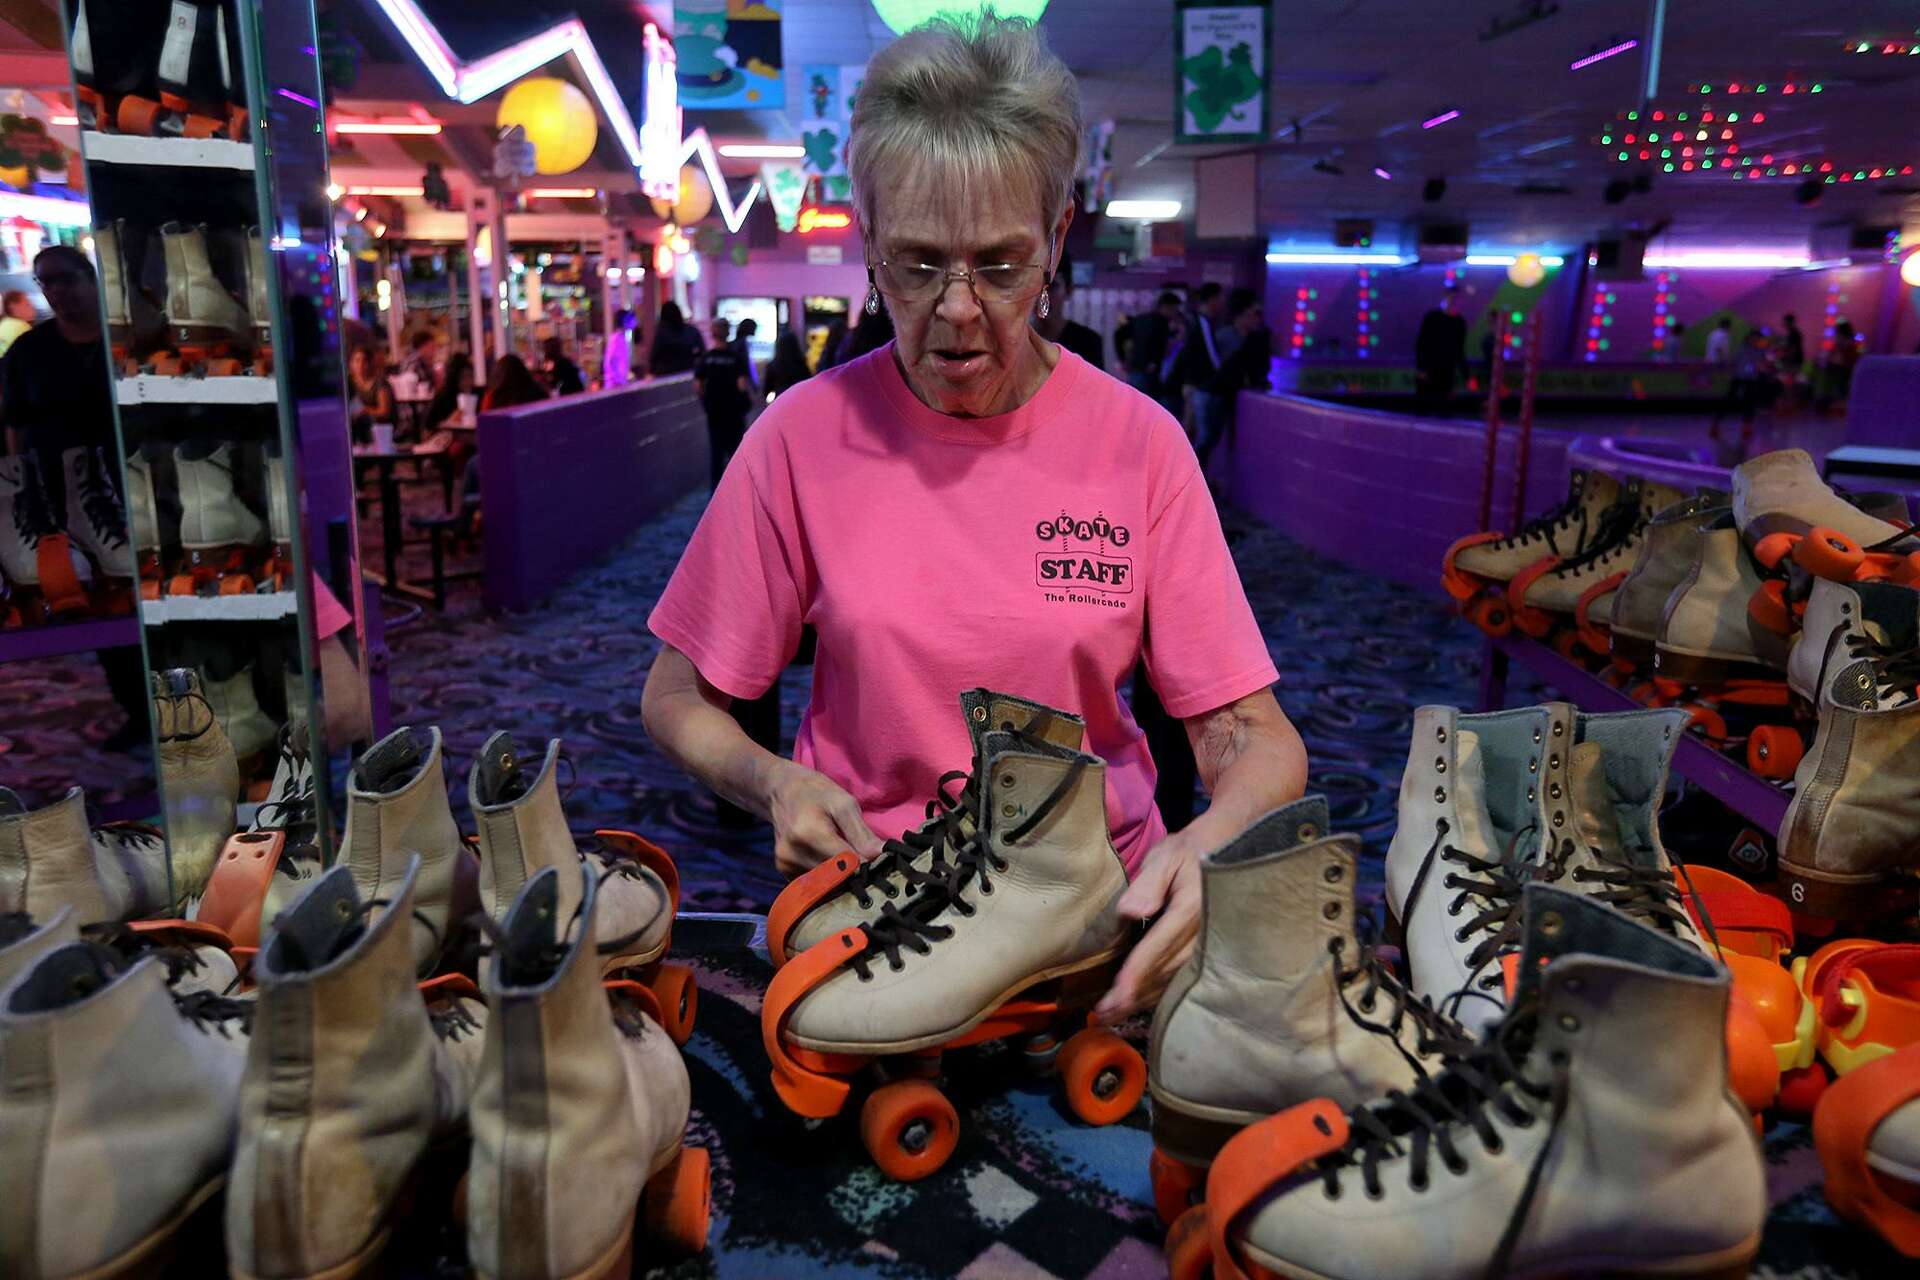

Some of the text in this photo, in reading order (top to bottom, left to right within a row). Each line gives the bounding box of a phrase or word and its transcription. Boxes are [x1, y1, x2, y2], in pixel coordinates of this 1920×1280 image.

[1037, 516, 1129, 547] SKATE
[1040, 558, 1129, 585] STAFF
[1044, 593, 1127, 609] The Rollercade
[1791, 882, 1804, 903] 6
